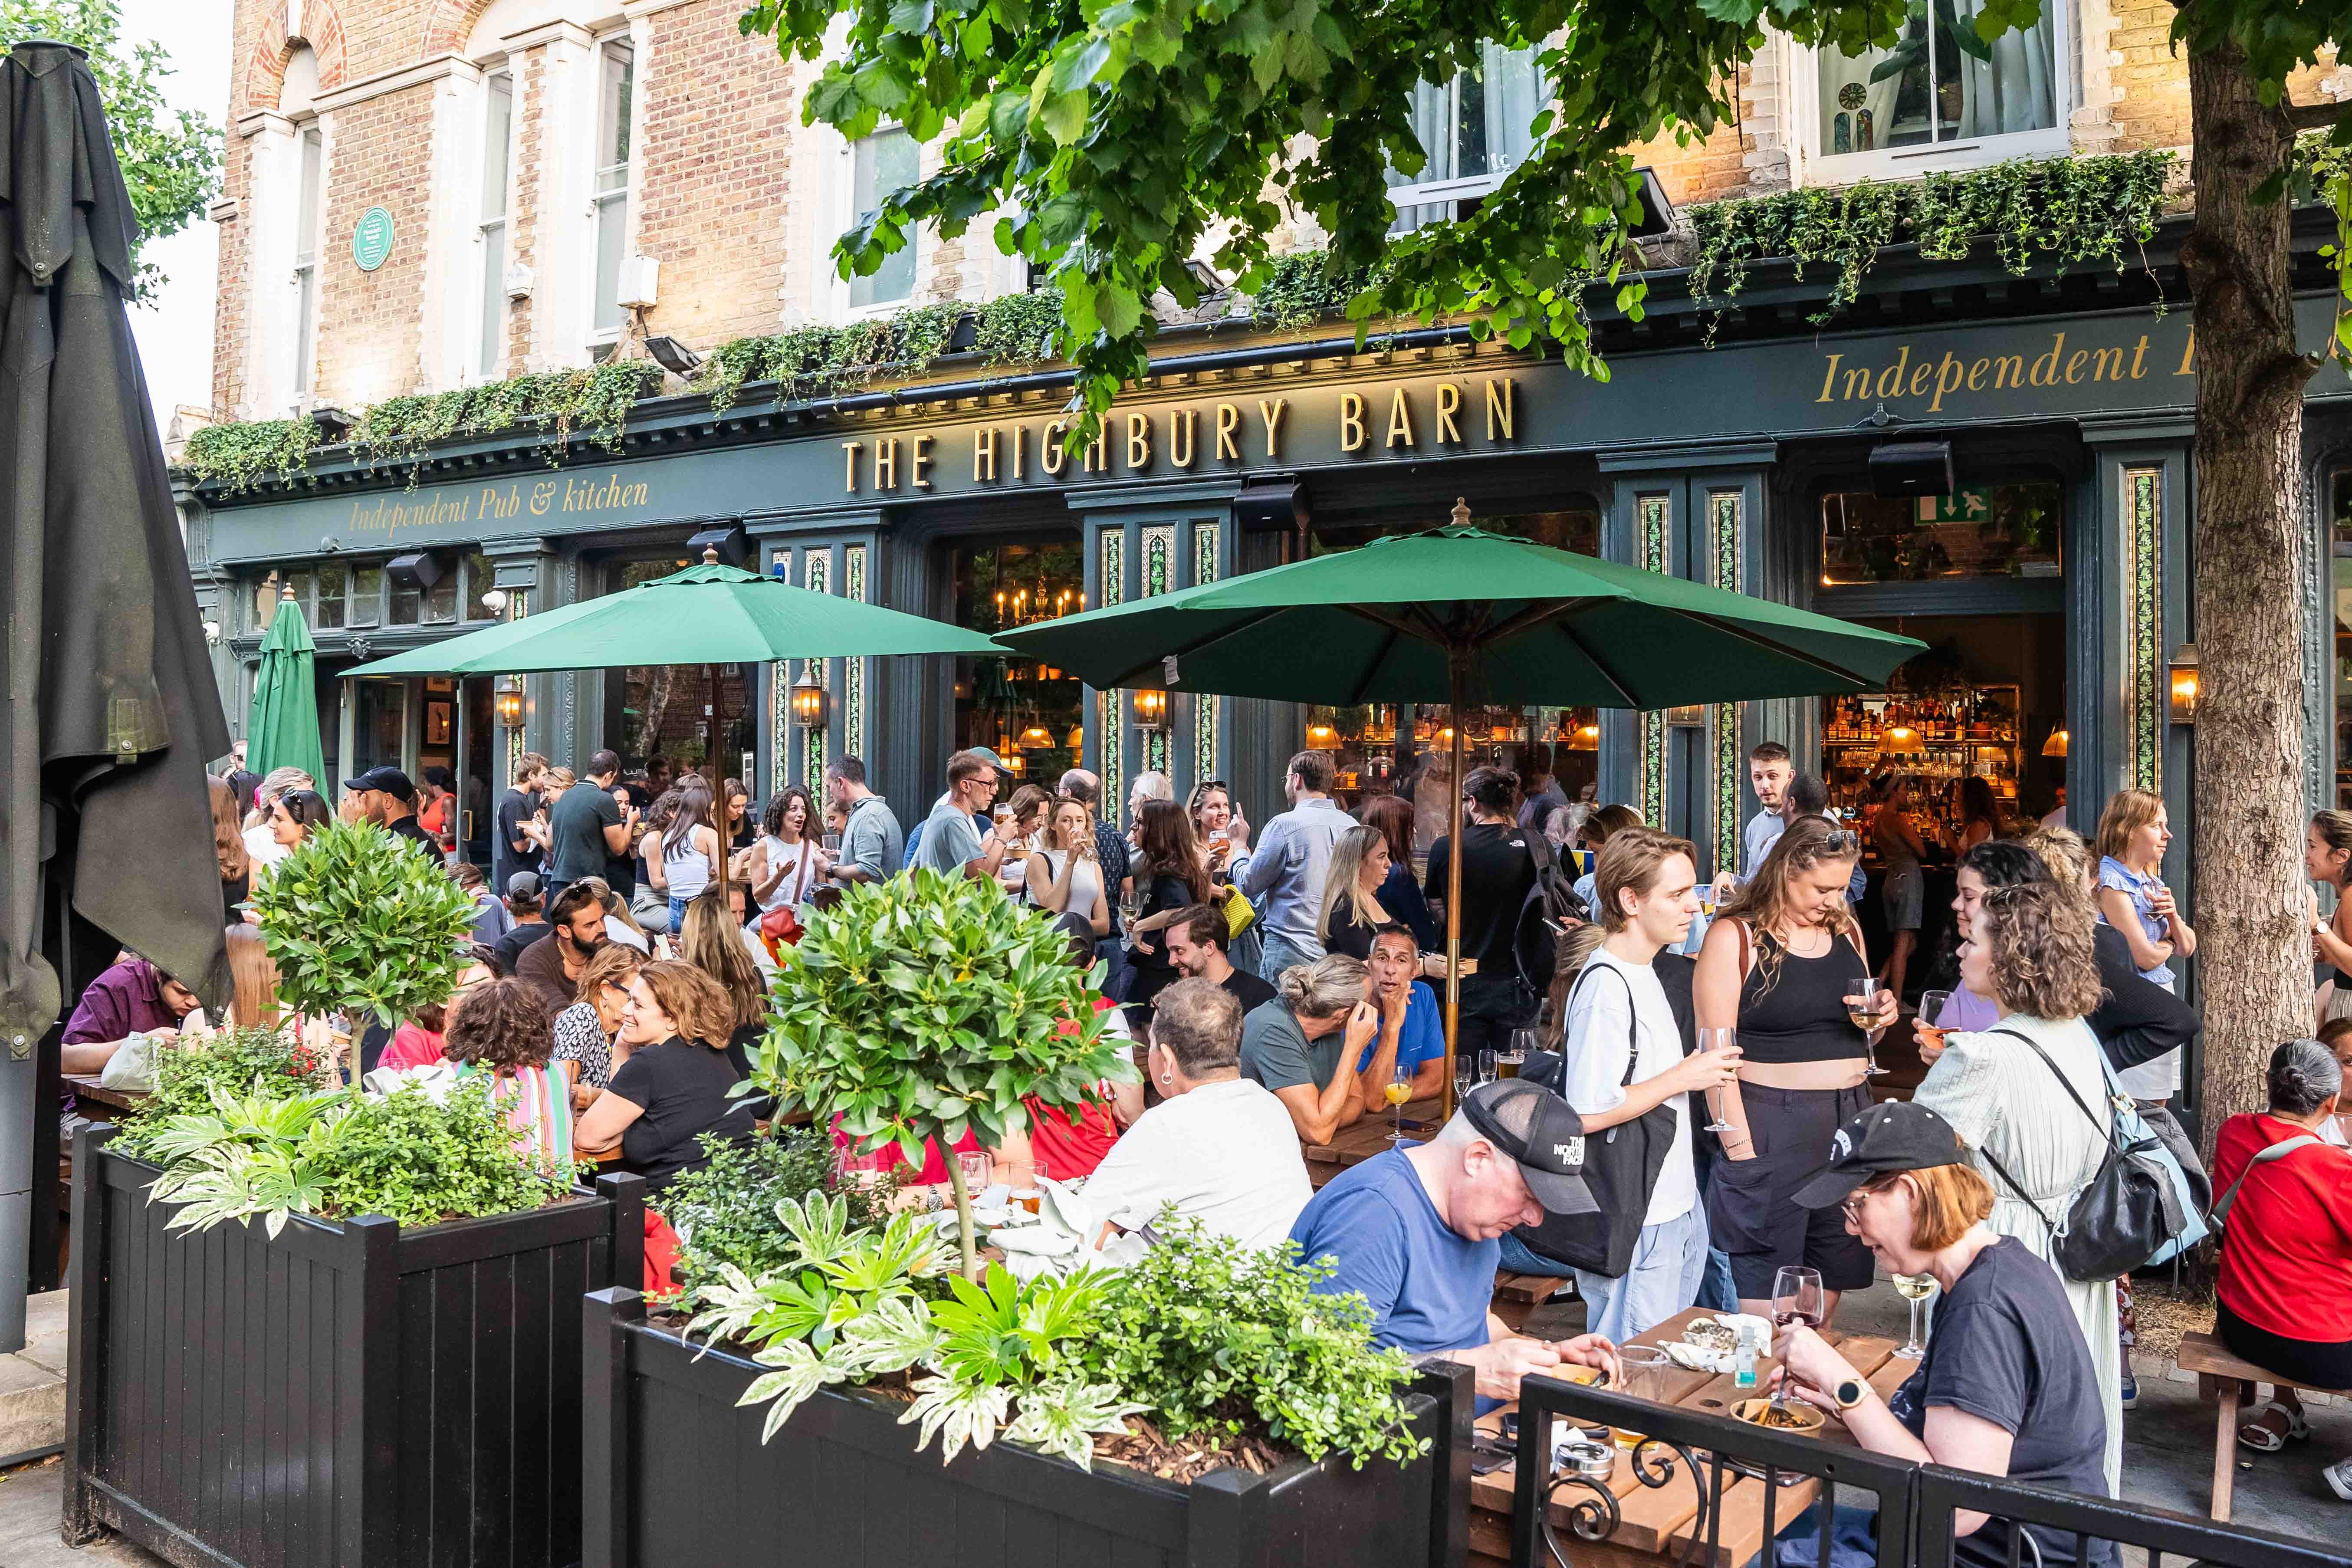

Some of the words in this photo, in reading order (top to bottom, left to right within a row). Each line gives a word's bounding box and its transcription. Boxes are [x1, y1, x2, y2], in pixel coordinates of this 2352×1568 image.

[1815, 332, 2150, 412] Independent
[842, 434, 933, 492] THE
[974, 398, 1288, 482] HIGHBURY
[1340, 378, 1514, 452] BARN
[350, 493, 469, 538] Independent
[476, 485, 521, 520] Pub
[529, 481, 556, 516] &
[562, 474, 648, 512] kitchen
